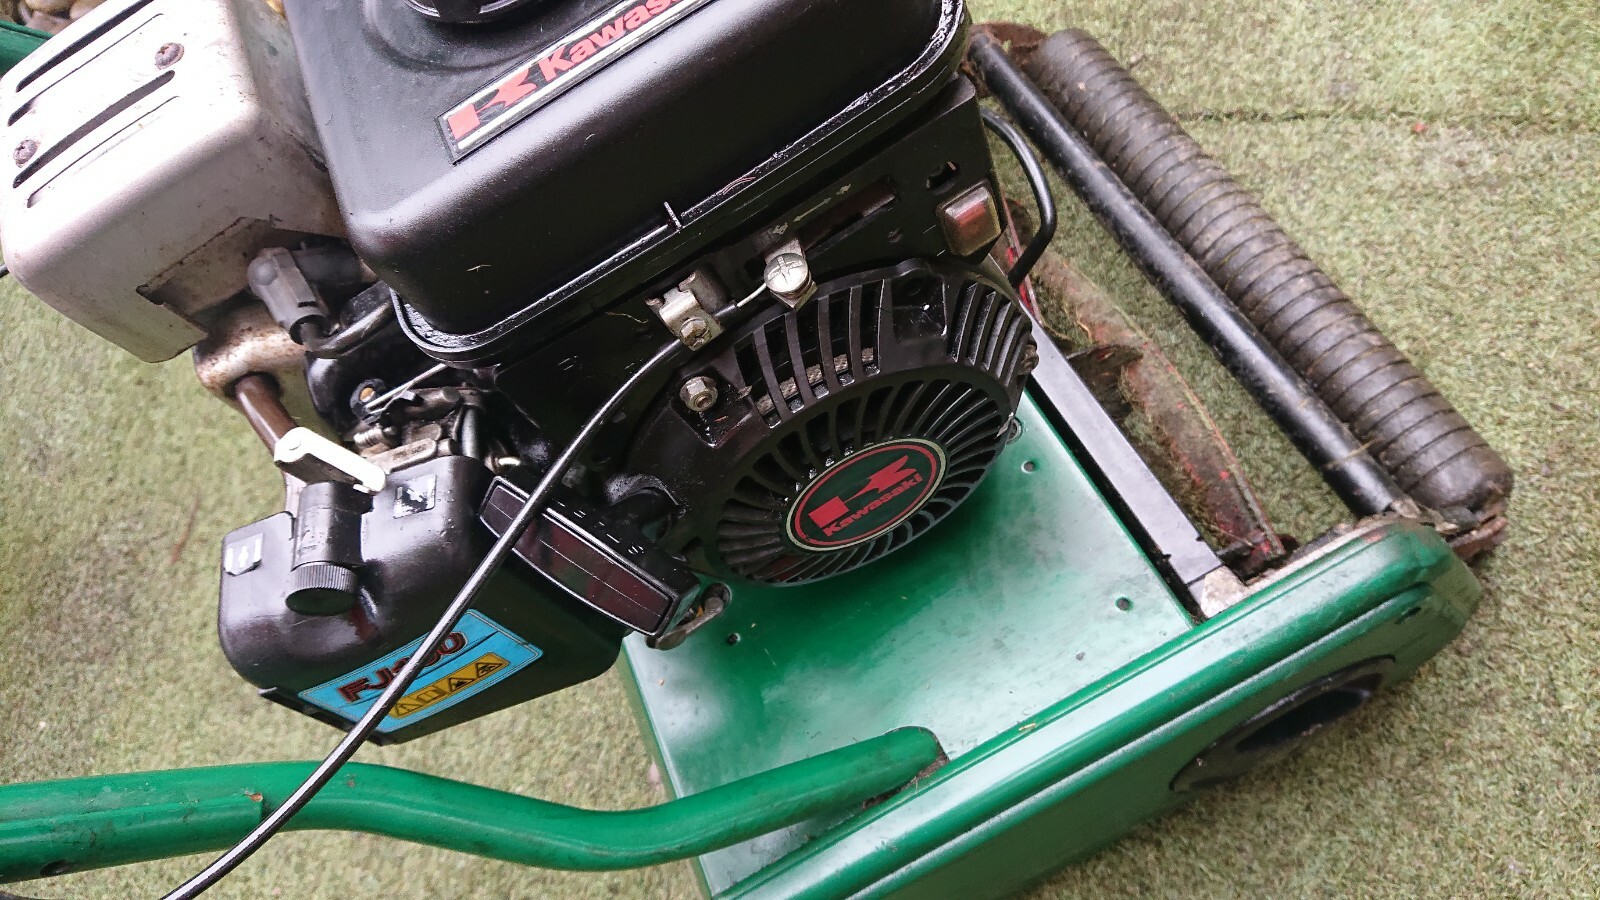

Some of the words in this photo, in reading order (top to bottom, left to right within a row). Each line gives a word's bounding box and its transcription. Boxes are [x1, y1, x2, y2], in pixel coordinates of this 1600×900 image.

[537, 0, 678, 82] Kawas
[822, 473, 923, 537] Kawasaki
[337, 631, 467, 703] FJ0
